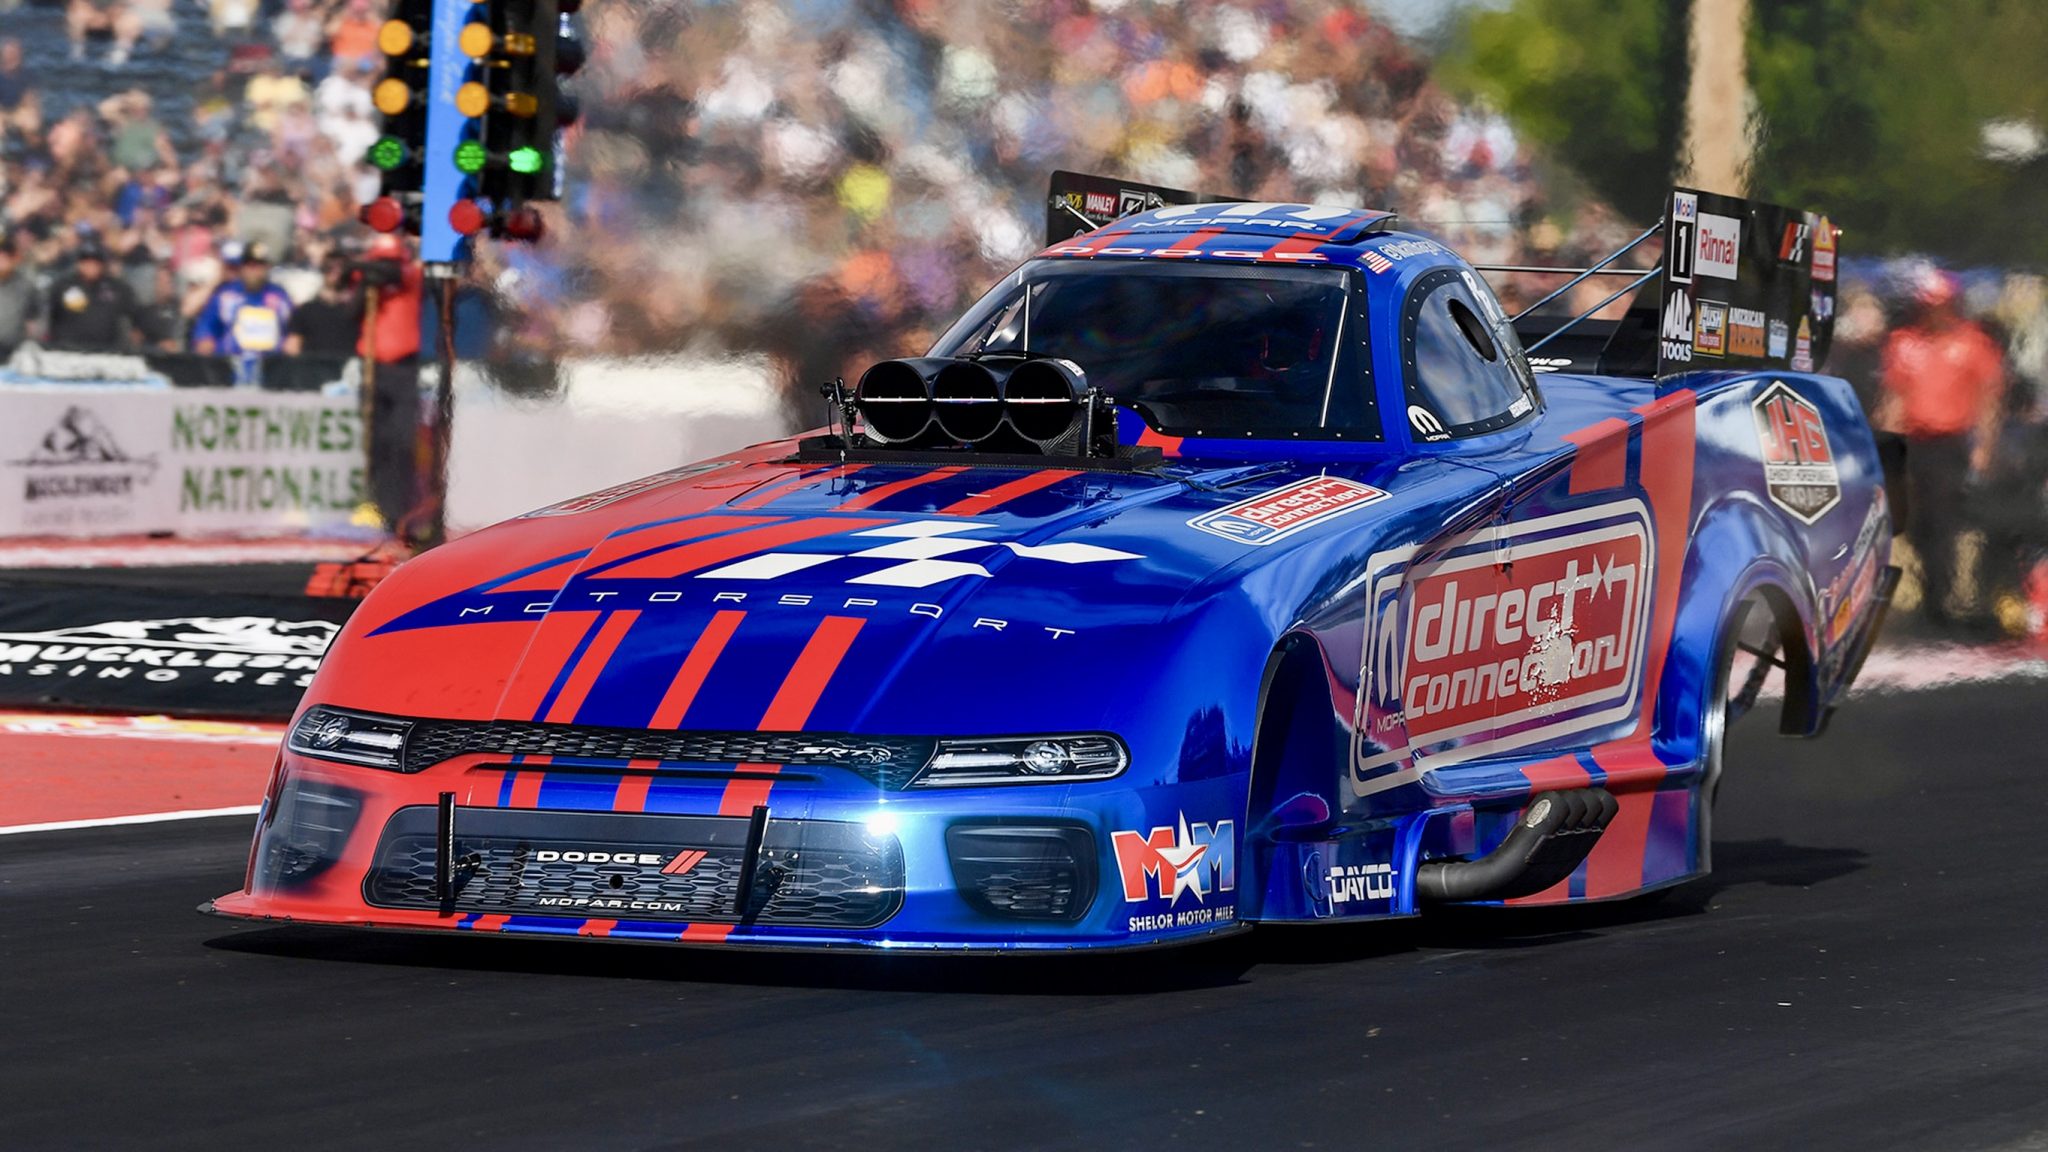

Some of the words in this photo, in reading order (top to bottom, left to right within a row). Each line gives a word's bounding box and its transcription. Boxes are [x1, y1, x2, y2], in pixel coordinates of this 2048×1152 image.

[1086, 193, 1116, 213] MANLEY
[1675, 197, 1695, 217] Mobil
[1132, 218, 1318, 231] MOPAR
[1050, 246, 1329, 262] DODGE
[1679, 226, 1687, 273] 1
[1700, 228, 1736, 265] Rinnai
[1662, 288, 1693, 341] MAC
[1662, 341, 1692, 362] TOOLS
[1762, 394, 1831, 464] JHG
[180, 467, 365, 513] NATIONALS
[1241, 485, 1324, 520] direct
[1263, 487, 1365, 526] connection
[1414, 559, 1586, 663] direct
[1405, 634, 1625, 721] connecon
[796, 747, 873, 758] SRT
[536, 850, 662, 865] DODGE
[1327, 863, 1396, 903] DAYCO
[539, 897, 682, 912] MOPAR.COM
[1128, 913, 1173, 933] SHELOR
[1177, 909, 1212, 926] MOTOR
[1214, 905, 1235, 922] MILE
